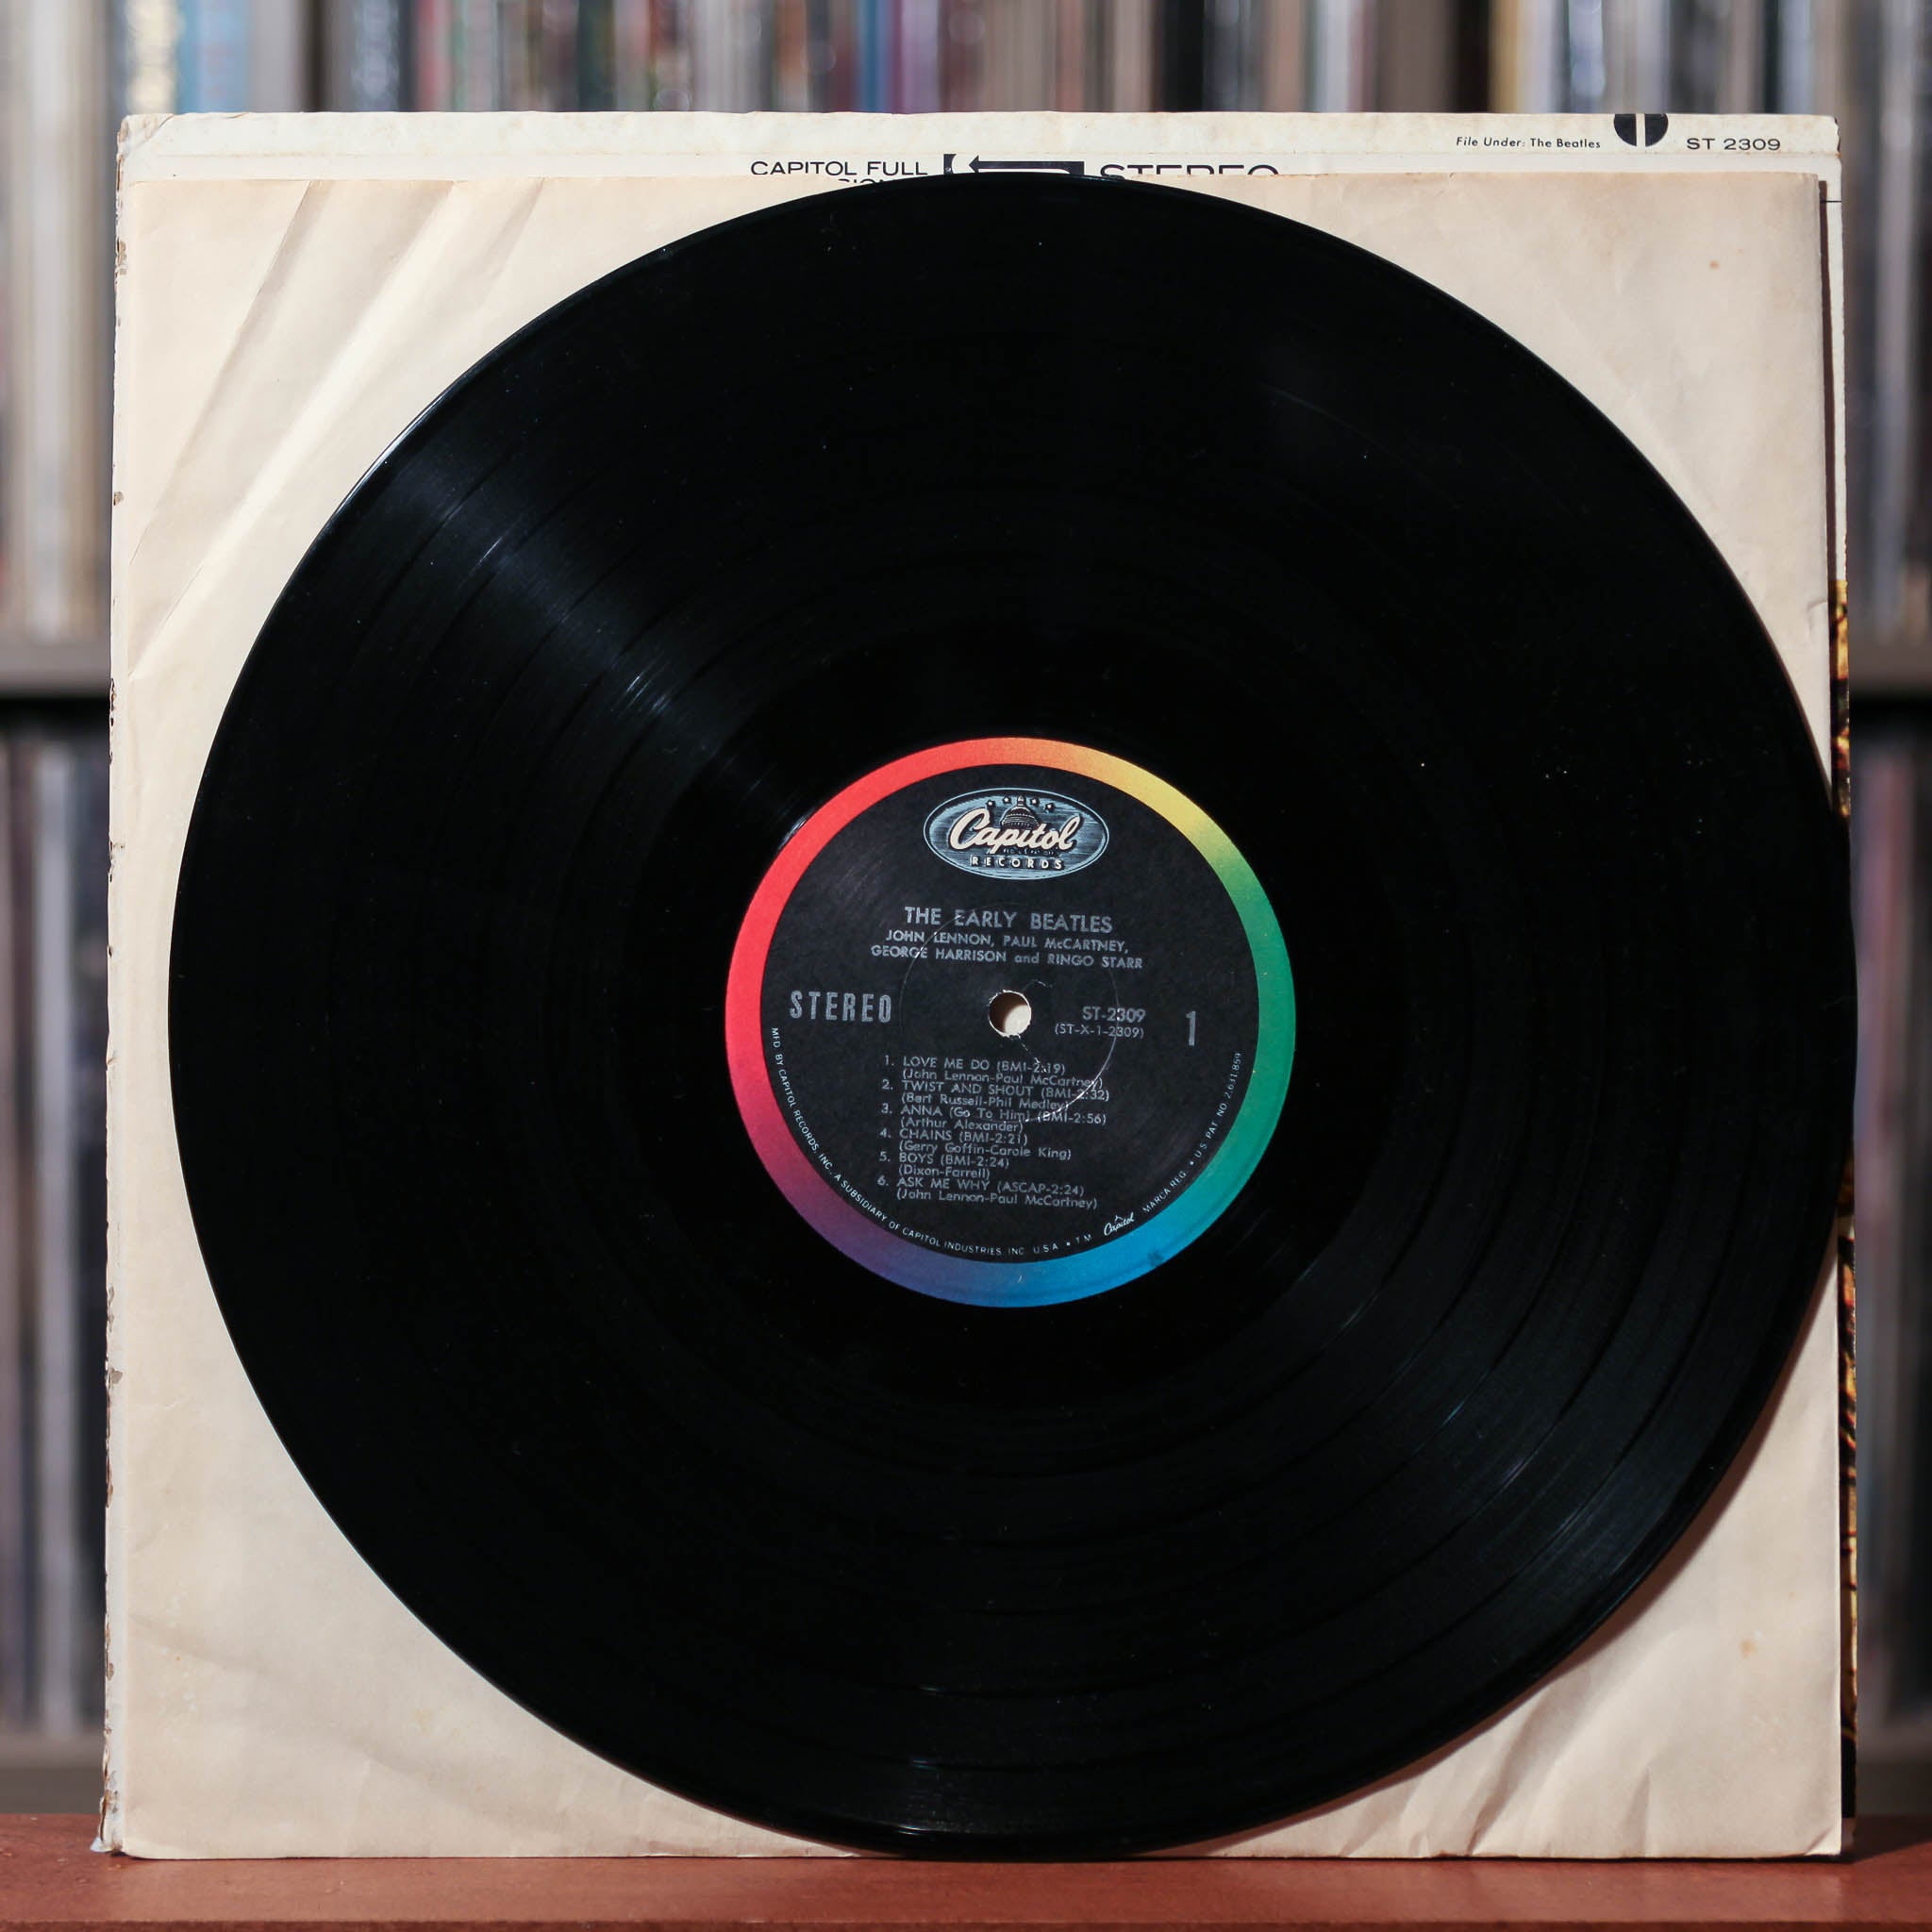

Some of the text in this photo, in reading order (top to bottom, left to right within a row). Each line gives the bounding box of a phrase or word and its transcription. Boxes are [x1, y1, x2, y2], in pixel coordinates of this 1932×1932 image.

[1456, 137, 1601, 149] File Under: The Beatles
[1686, 138, 1781, 152] ST 2309
[750, 160, 928, 176] CAPITOL FULL
[948, 807, 1083, 854] Capitol
[971, 855, 1064, 870] RECORDS
[904, 907, 1113, 933] THE EARLY BEATLES
[886, 929, 1129, 954] JOHN LENNON, PAUL McCARTNEY,
[871, 944, 1143, 969] GEORGE HARRISON and RINGO STARR
[790, 990, 891, 1024] STEREO
[1082, 1006, 1146, 1023] ST-2309
[1055, 1024, 1145, 1040] (ST-X-1-2309)
[1186, 1010, 1197, 1046] 1
[774, 1053, 784, 1066] BY
[885, 1055, 895, 1067] 1.
[903, 1056, 937, 1068] LOVE
[944, 1057, 963, 1070] ME
[971, 1058, 991, 1071] DO
[778, 1068, 797, 1108] CAPITOL
[882, 1078, 893, 1091] 2.
[901, 1079, 944, 1092] TWIST
[950, 1082, 982, 1094] AND
[988, 1084, 1035, 1096] SHOUT
[902, 1069, 1103, 1090] (John Lennon-Paul McCartney)
[940, 1093, 1012, 1108] Russell-Phil
[881, 1102, 892, 1114] 3.
[900, 1104, 943, 1116] ANNA
[949, 1106, 971, 1119] (Go
[976, 1107, 993, 1119] To
[1000, 1109, 1030, 1122] Him)
[879, 1127, 891, 1139] 4.
[899, 1127, 953, 1141] CHAINS
[900, 1116, 1024, 1133] (Arthur Alexander)
[899, 1140, 1072, 1160] (Gerry Goffin-Carole King)
[878, 1151, 1009, 1169] 5. BOYS (BMI-2:24)
[834, 1173, 842, 1181] A
[898, 1164, 991, 1180] (Dixon-Farrell)
[876, 1174, 1085, 1197] 6. ASK ME WHY (ASCAP-2:24)
[841, 1179, 889, 1222] SUBSIDIARY
[896, 1188, 1098, 1209] (John Lennon-Paul McCartney)
[1141, 1187, 1172, 1213] MARCA
[889, 1221, 902, 1230] OF
[1103, 1211, 1136, 1237] Capitol
[902, 1227, 941, 1247] CAPITOL
